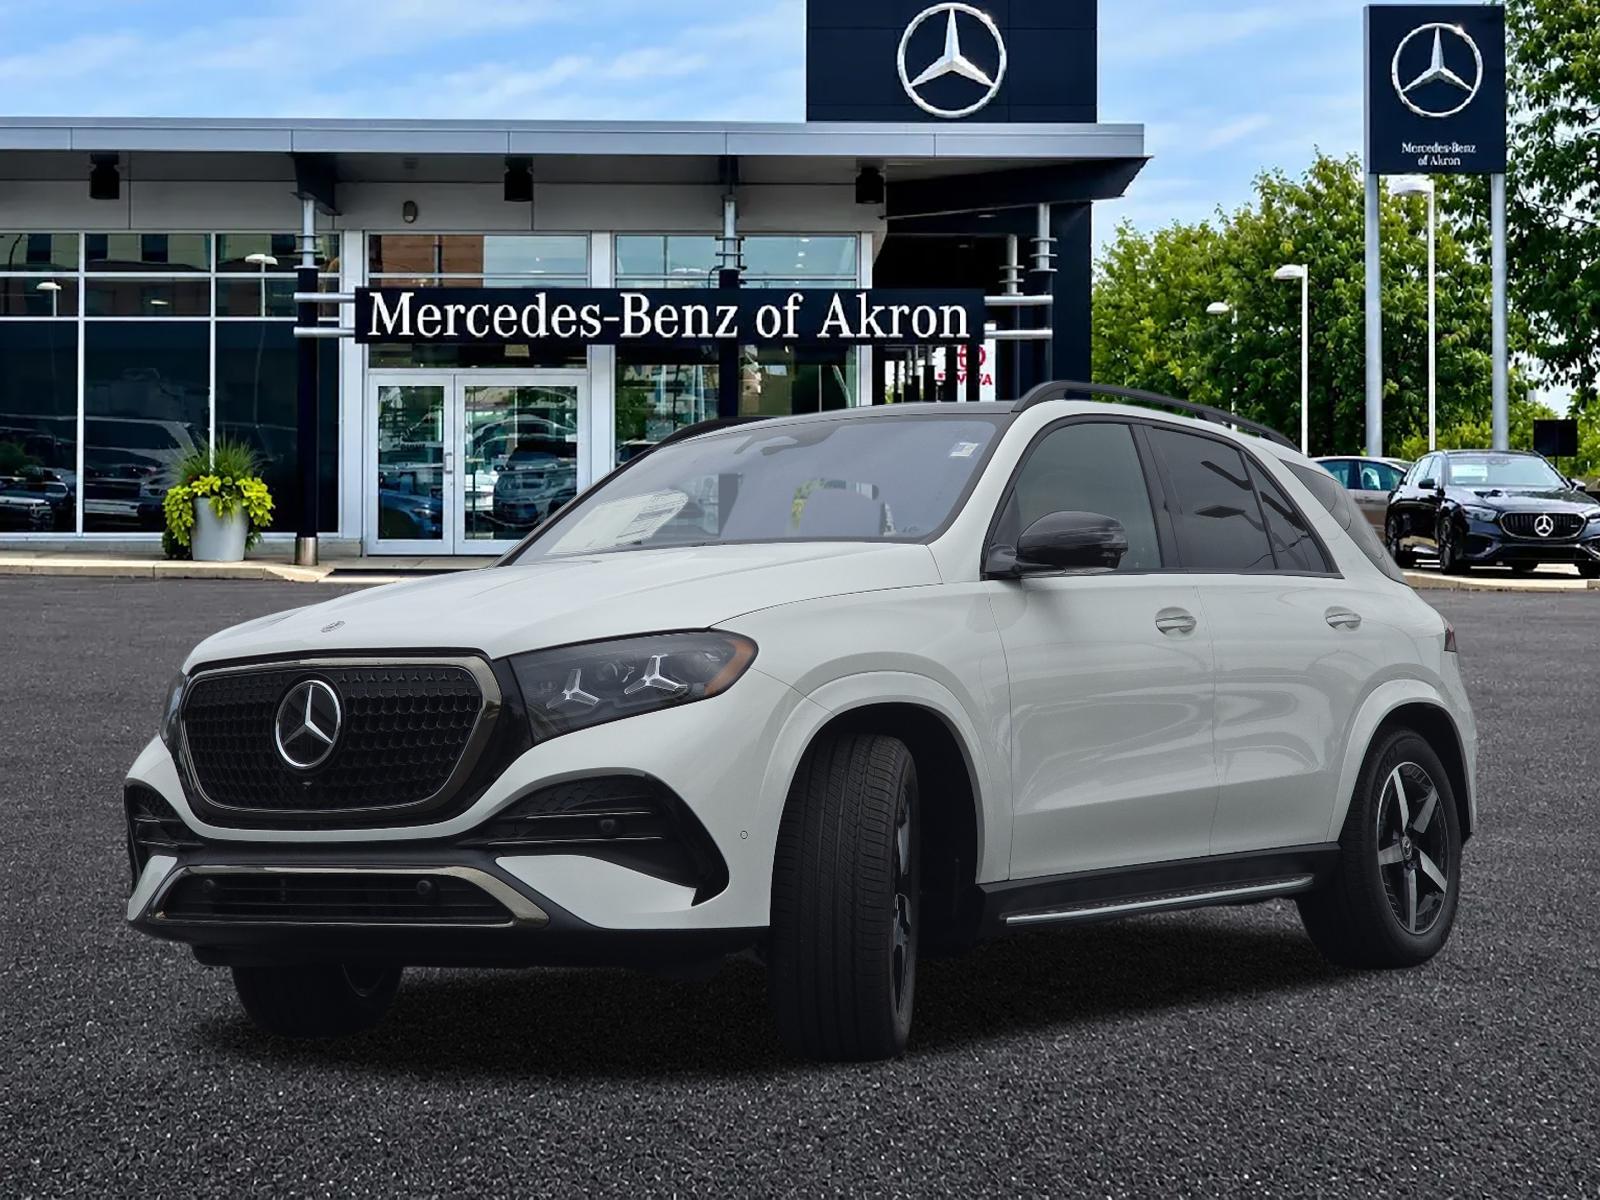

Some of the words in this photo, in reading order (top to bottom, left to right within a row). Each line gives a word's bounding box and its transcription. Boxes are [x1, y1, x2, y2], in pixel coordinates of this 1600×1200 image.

[1401, 142, 1476, 153] Mercedes-Benz
[1418, 154, 1428, 166] of
[1430, 154, 1461, 166] Akron
[367, 292, 738, 338] Mercedes-Benz
[756, 292, 804, 338] of
[816, 293, 970, 338] Akron
